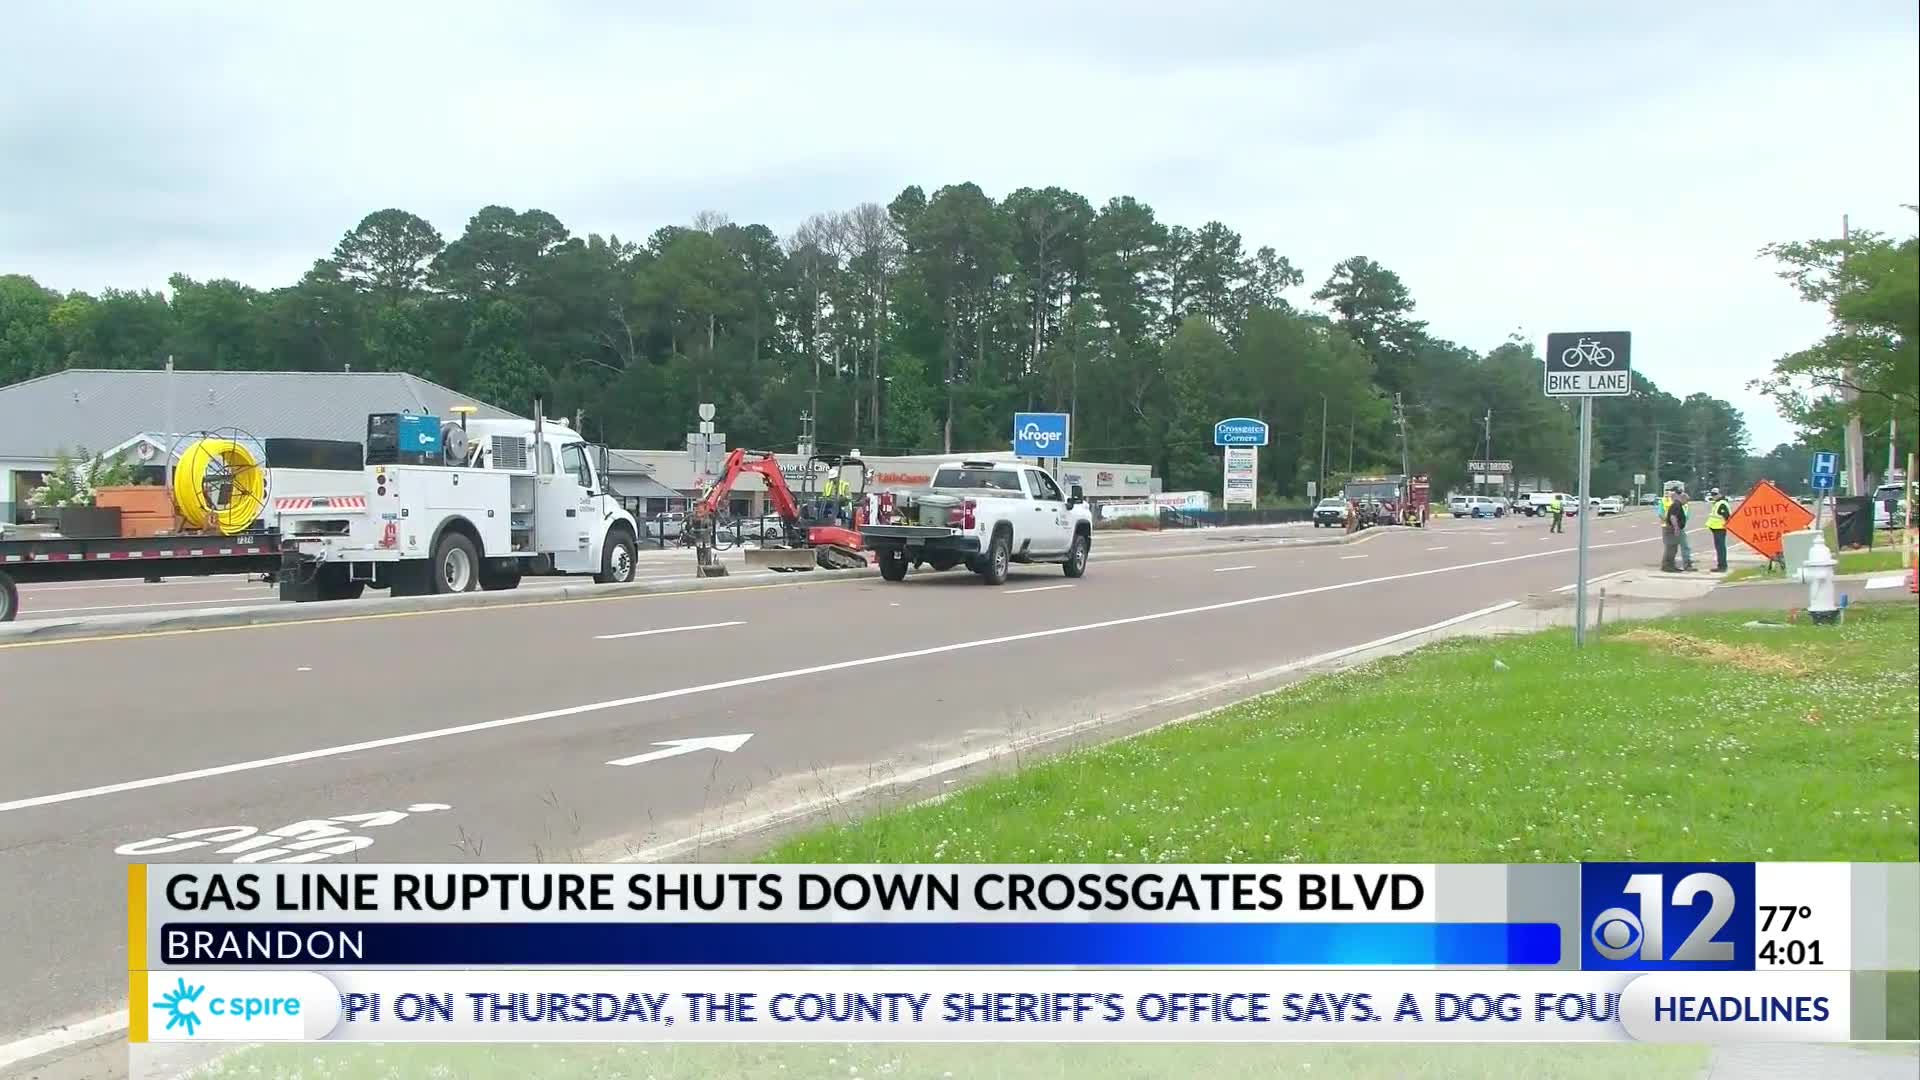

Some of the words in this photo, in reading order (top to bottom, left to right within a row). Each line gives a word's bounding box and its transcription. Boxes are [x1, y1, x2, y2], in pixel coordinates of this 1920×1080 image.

[1549, 375, 1581, 390] BIKE
[1588, 374, 1626, 390] LANE
[1218, 424, 1264, 433] Crossgates
[1018, 422, 1062, 449] Kroger
[1224, 433, 1257, 442] Corners
[776, 463, 797, 472] aylor
[1816, 454, 1835, 473] H
[1744, 503, 1789, 517] UTILITY
[1752, 518, 1787, 529] WORK
[1752, 530, 1787, 543] AHEA
